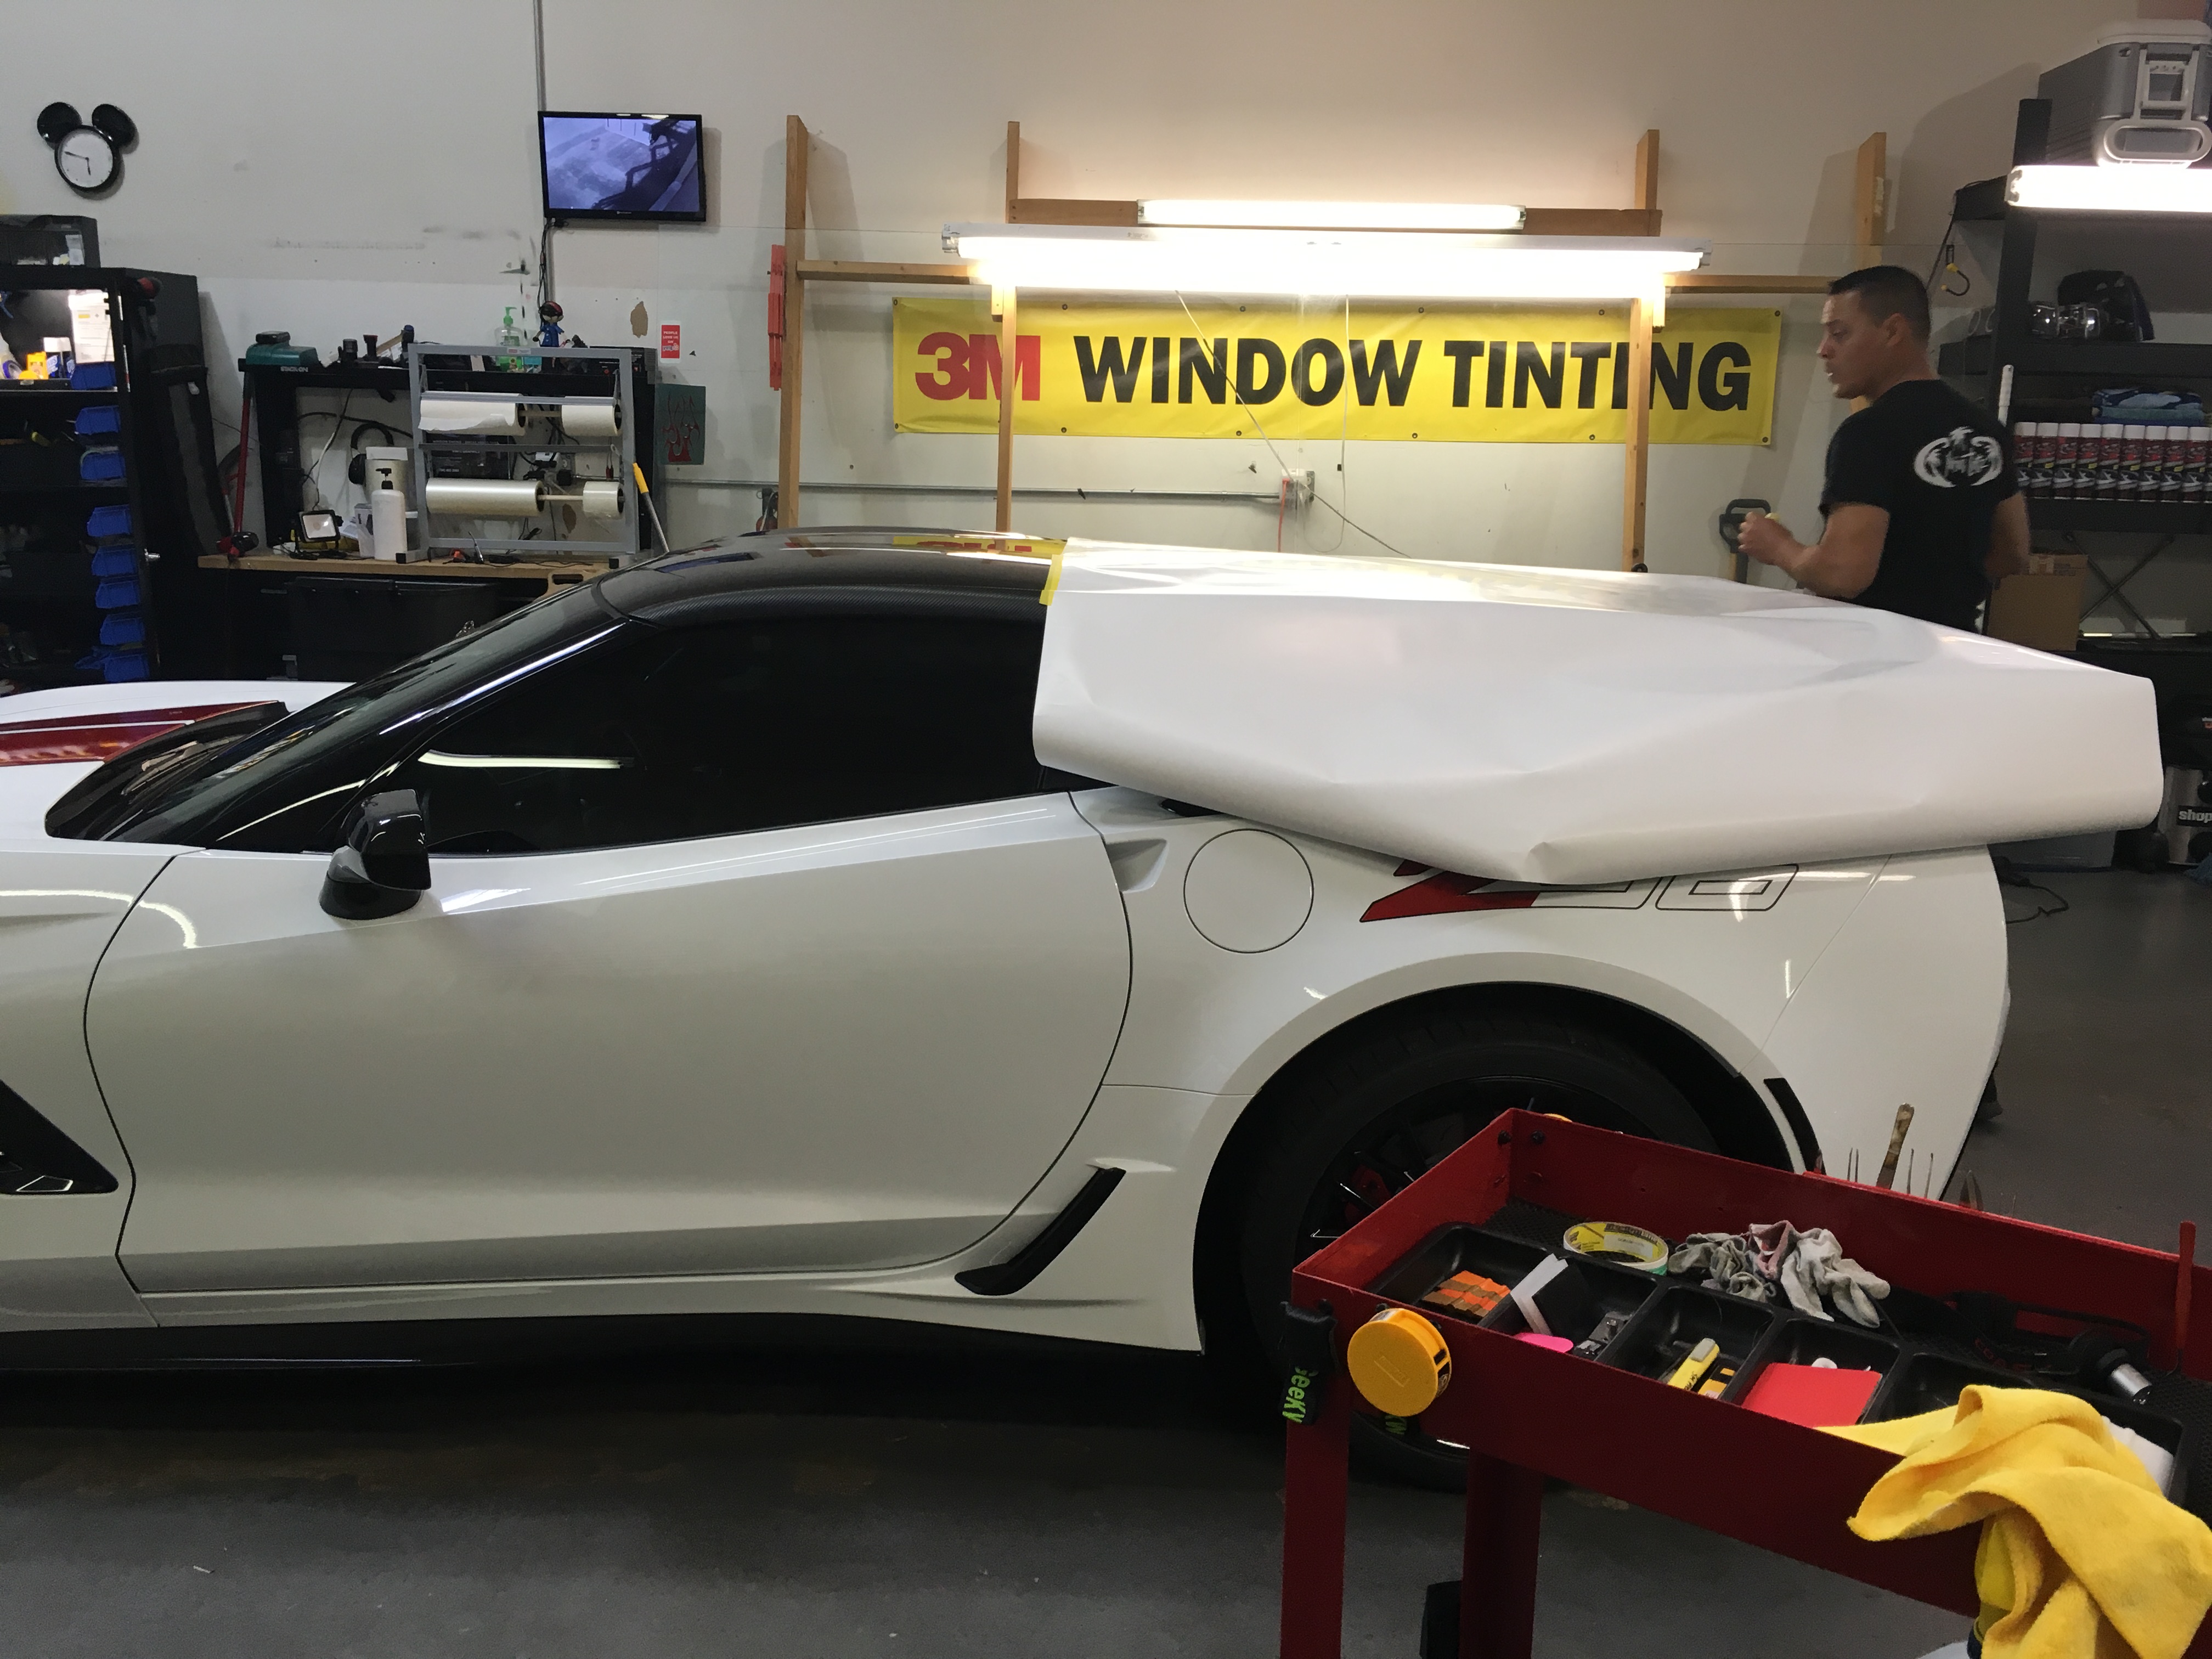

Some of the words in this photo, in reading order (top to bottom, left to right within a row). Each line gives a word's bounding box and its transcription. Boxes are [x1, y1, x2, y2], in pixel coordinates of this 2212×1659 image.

[915, 332, 1040, 400] 3M
[1074, 336, 1423, 406] WINDOW
[1444, 340, 1752, 411] TINTING
